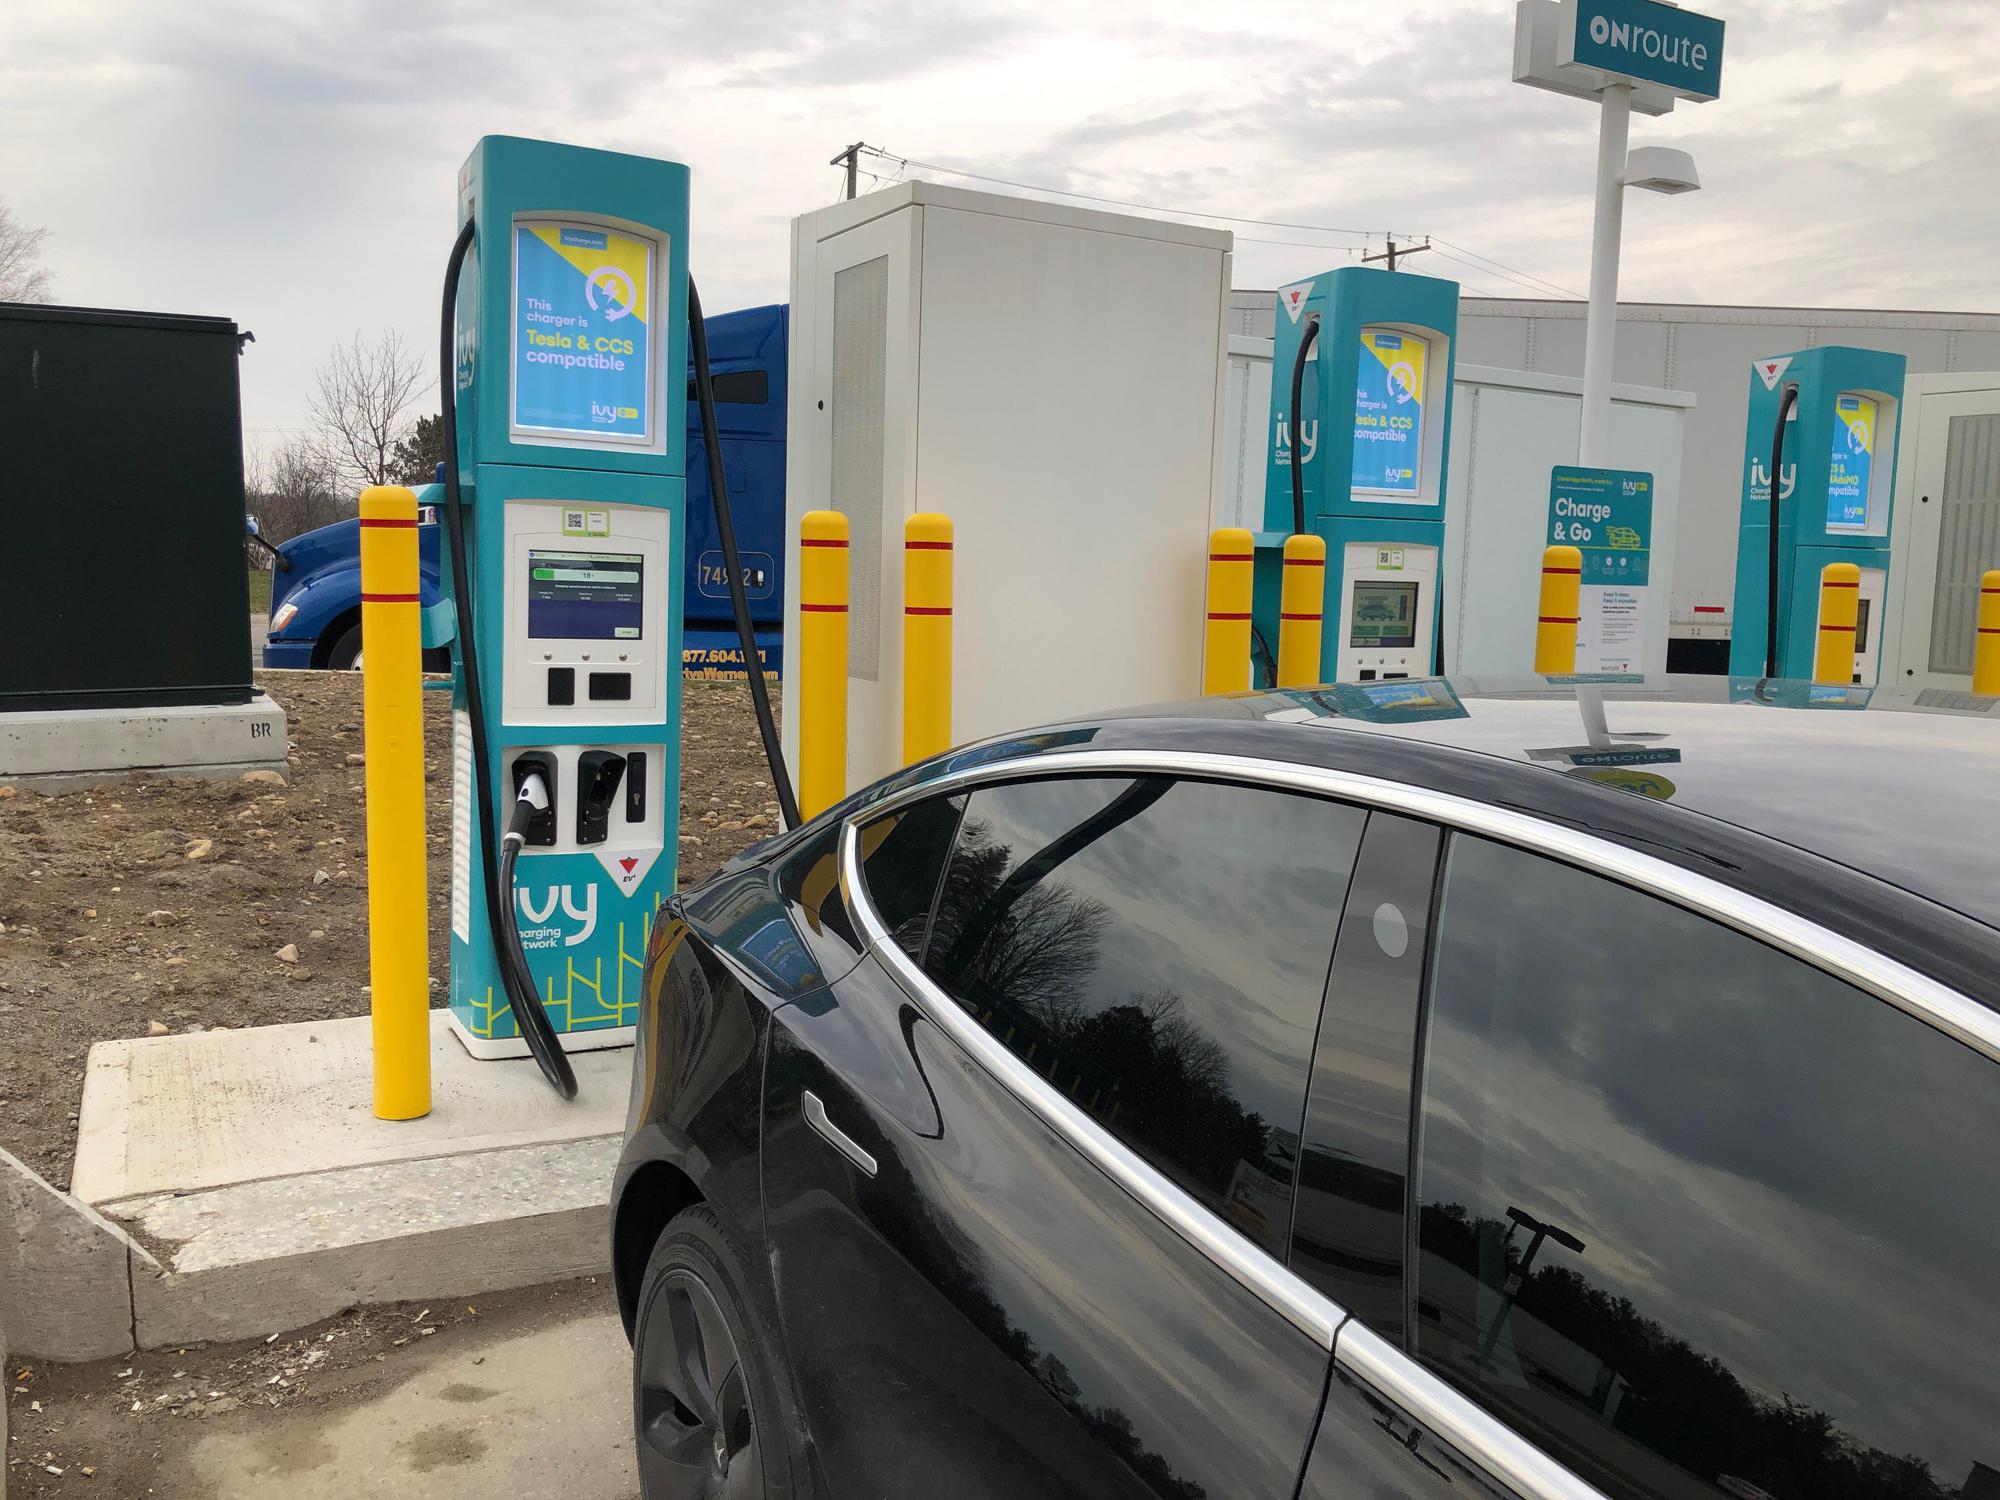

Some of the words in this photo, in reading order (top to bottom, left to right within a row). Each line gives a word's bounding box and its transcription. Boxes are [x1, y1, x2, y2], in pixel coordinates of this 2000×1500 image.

[1590, 15, 1708, 71] ONroute
[526, 298, 553, 311] This
[526, 312, 576, 328] charger
[578, 316, 589, 328] is
[526, 329, 572, 349] Tesla
[576, 335, 590, 351] &
[594, 337, 634, 356] CCS
[526, 351, 625, 371] compatible
[1356, 389, 1368, 399] his
[591, 401, 617, 424] ivy
[1356, 399, 1380, 410] harger
[1355, 413, 1377, 426] esla
[1390, 416, 1413, 429] CCS
[1385, 465, 1400, 482] ivy
[1623, 478, 1637, 496] ivy
[1555, 497, 1611, 523] Charge
[1554, 521, 1566, 540] &
[1570, 522, 1592, 542] Go
[703, 566, 752, 587] 7492
[251, 722, 272, 739] BR
[521, 939, 558, 950] twork
